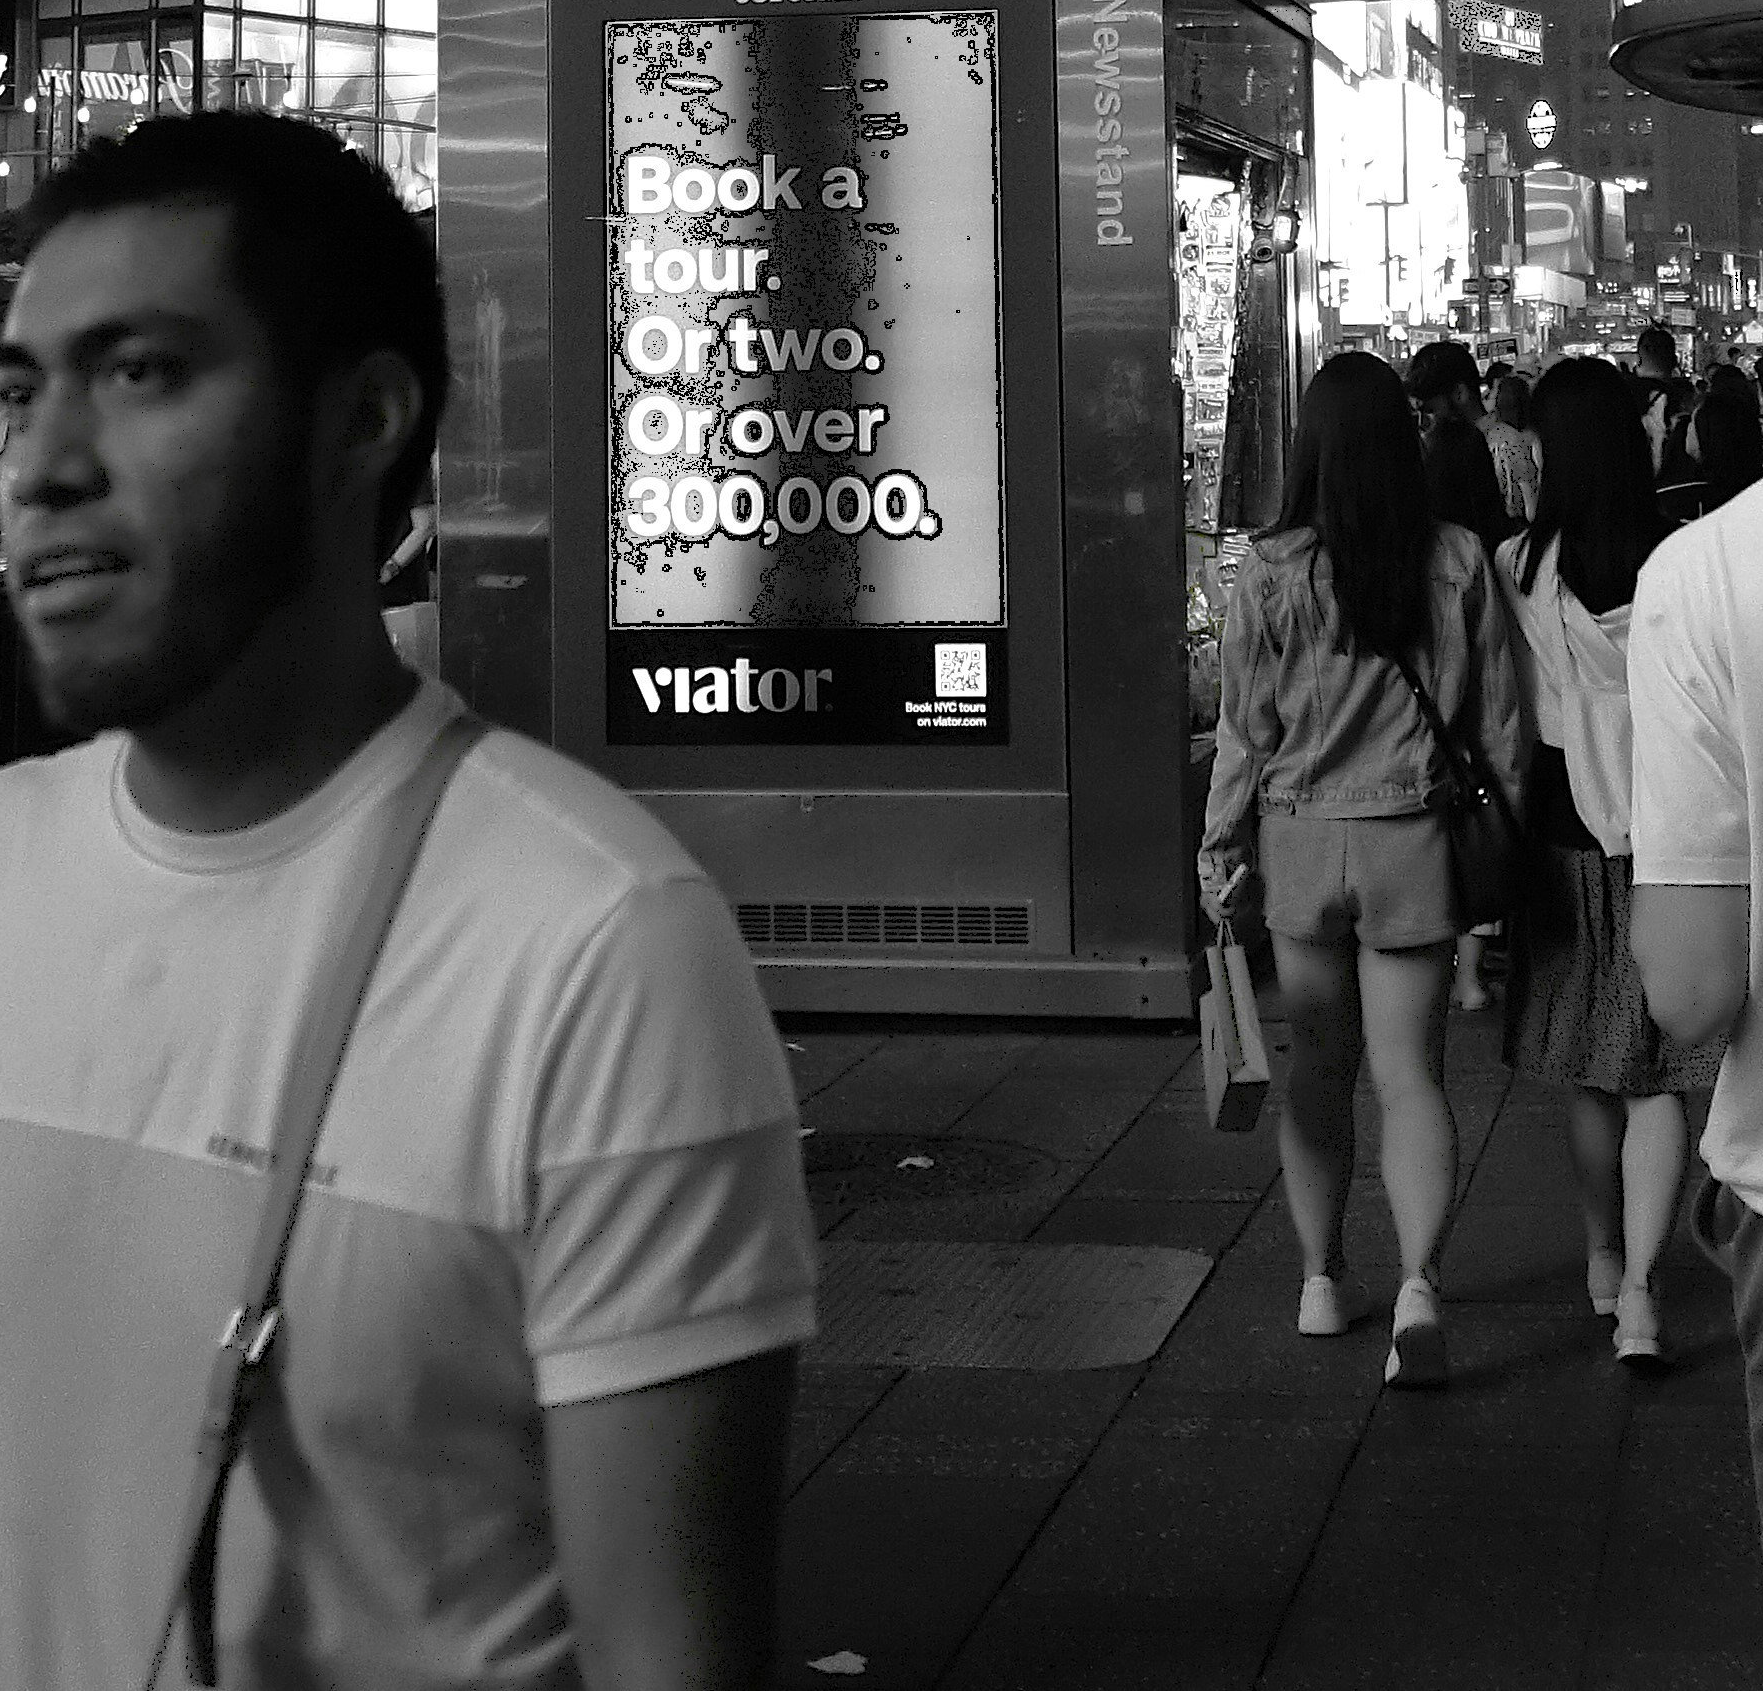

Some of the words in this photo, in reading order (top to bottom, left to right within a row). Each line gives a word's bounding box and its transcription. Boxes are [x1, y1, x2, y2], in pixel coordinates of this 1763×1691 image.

[625, 155, 801, 214] Book
[821, 165, 863, 211] a
[625, 246, 782, 293] tour.
[626, 316, 710, 375] Or
[729, 318, 881, 374] two.
[626, 398, 712, 455] Or
[731, 405, 886, 455] over
[626, 478, 938, 545] 300,000.
[905, 701, 932, 713] Book
[933, 700, 957, 713] NYC
[958, 701, 986, 713] tours
[917, 716, 931, 727] on
[932, 715, 987, 727] viator.com
